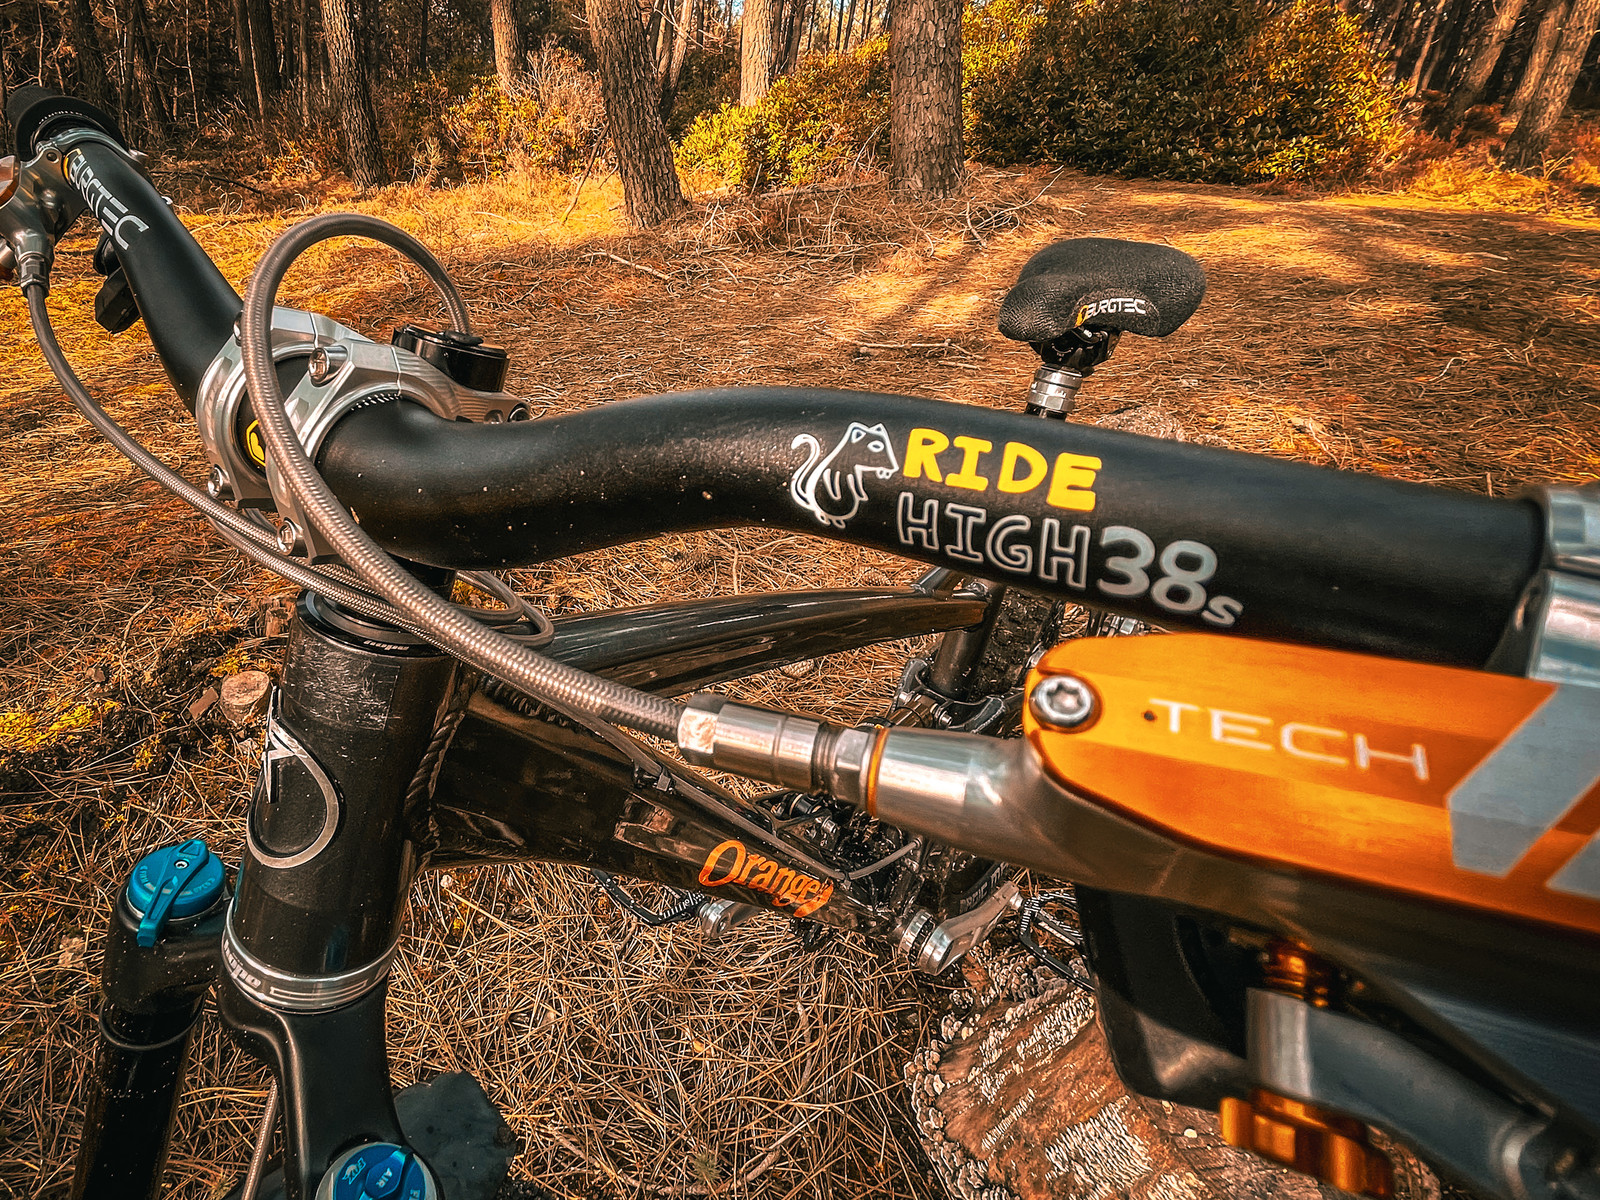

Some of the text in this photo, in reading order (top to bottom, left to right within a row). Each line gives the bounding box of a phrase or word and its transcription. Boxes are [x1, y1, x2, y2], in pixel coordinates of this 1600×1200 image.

[1086, 297, 1148, 319] BURGTEC
[903, 427, 1103, 512] RIDE
[896, 491, 1245, 627] HIGH 38s
[1148, 698, 1431, 781] TECH
[698, 839, 826, 907] Orange
[375, 1167, 394, 1189] AIR
